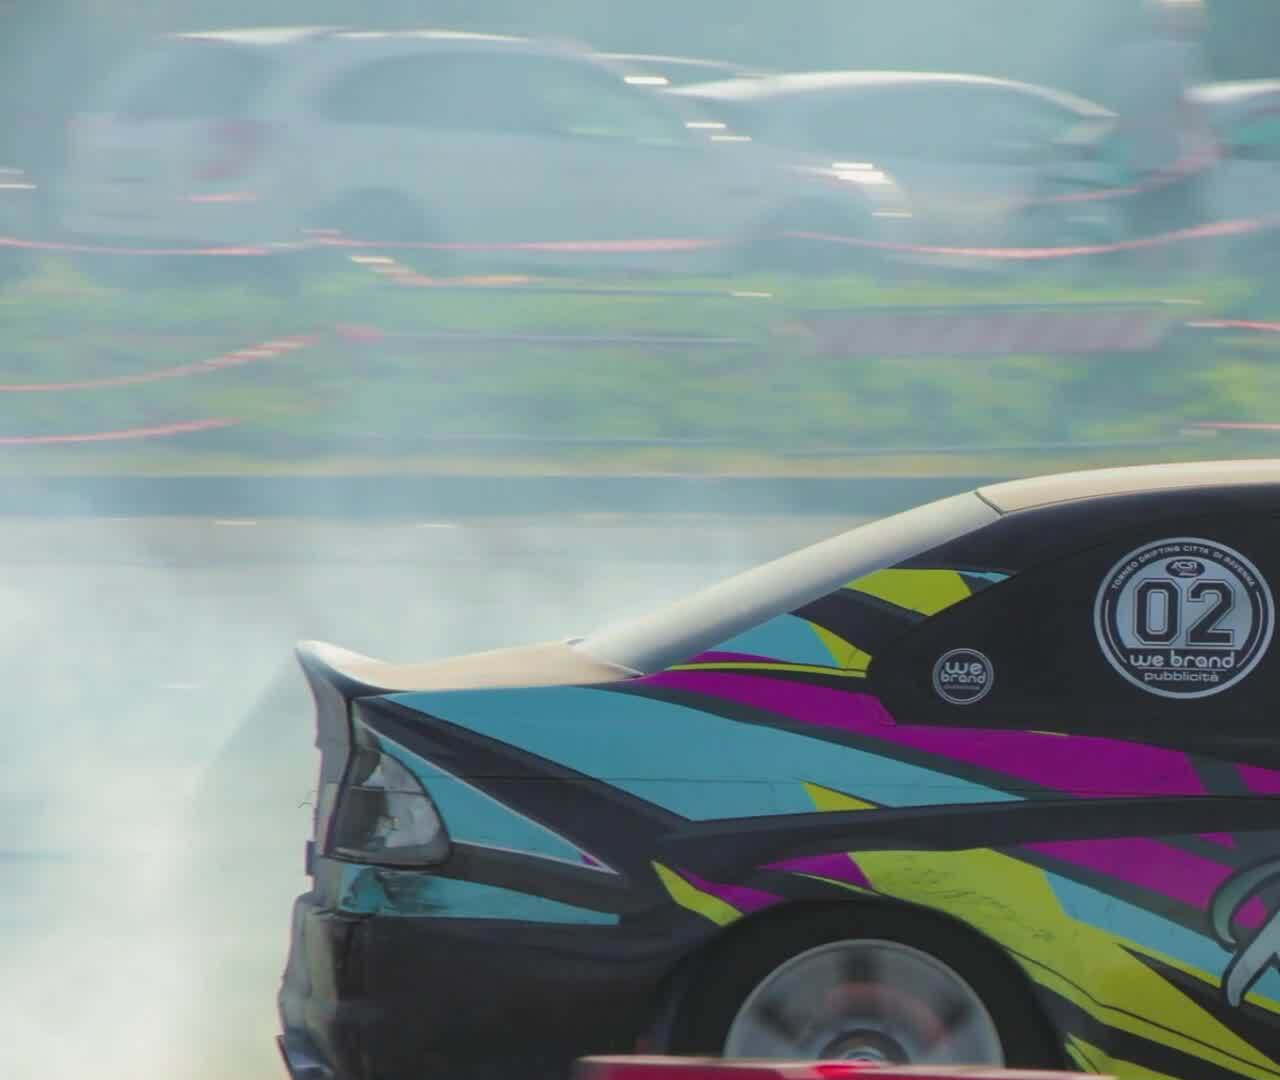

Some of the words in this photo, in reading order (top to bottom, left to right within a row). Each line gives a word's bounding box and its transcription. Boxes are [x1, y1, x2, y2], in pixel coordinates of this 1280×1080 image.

[1132, 577, 1236, 648] 02
[1130, 653, 1164, 667] we
[1171, 650, 1235, 669] brand
[944, 662, 983, 675] we
[940, 670, 987, 684] brand
[1144, 671, 1219, 683] pubblicità
